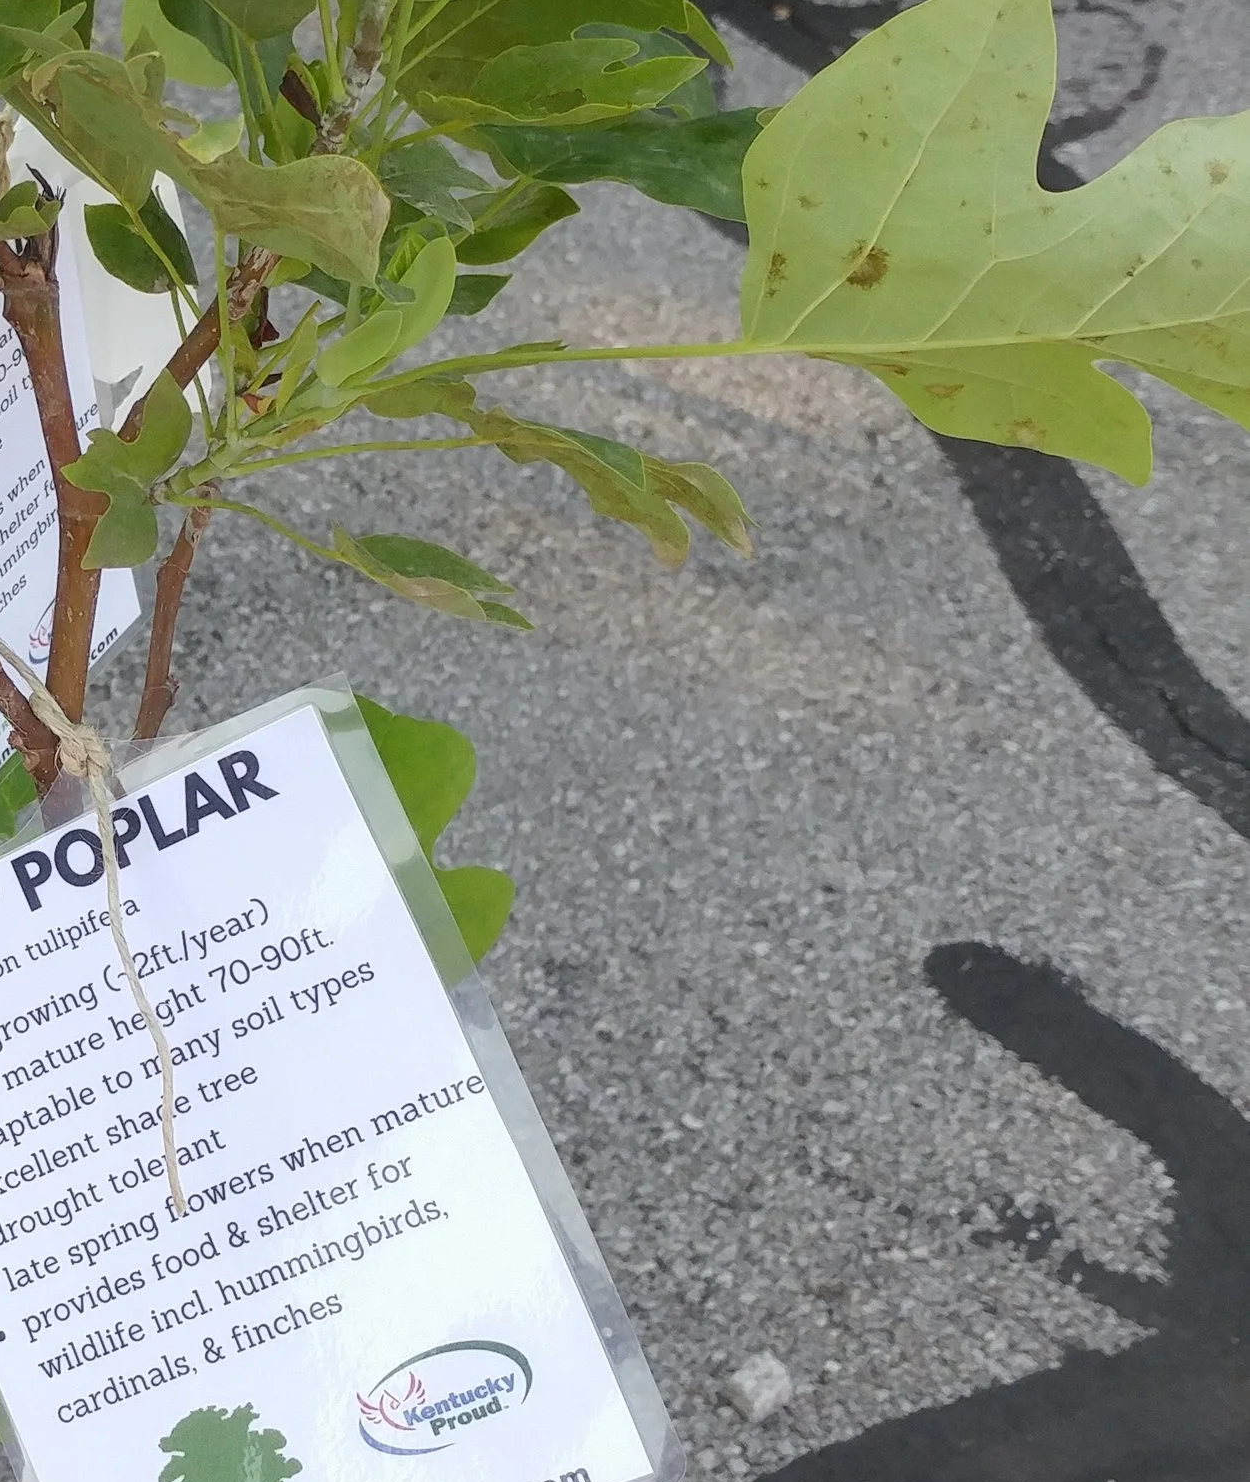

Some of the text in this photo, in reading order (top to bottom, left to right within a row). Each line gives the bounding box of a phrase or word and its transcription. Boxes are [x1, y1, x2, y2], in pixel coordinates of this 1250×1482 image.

[7, 459, 45, 502] when
[10, 750, 280, 912] POPLAR
[25, 898, 140, 961] tulipifea
[2, 1033, 105, 1091] mature
[108, 984, 206, 1041] heght
[208, 928, 334, 993] 70-90ft.
[102, 1071, 133, 1094] to
[232, 996, 285, 1039] soil
[290, 962, 374, 1014] types
[197, 1067, 258, 1102] tree
[2, 1076, 485, 1292] late spring fowers when mature
[22, 1156, 412, 1341] provides food & shelter for
[38, 1199, 448, 1378] wildlife incl. hummingbirds,
[58, 1294, 342, 1423] cardinals, & finches
[403, 1373, 514, 1430] Kentucky
